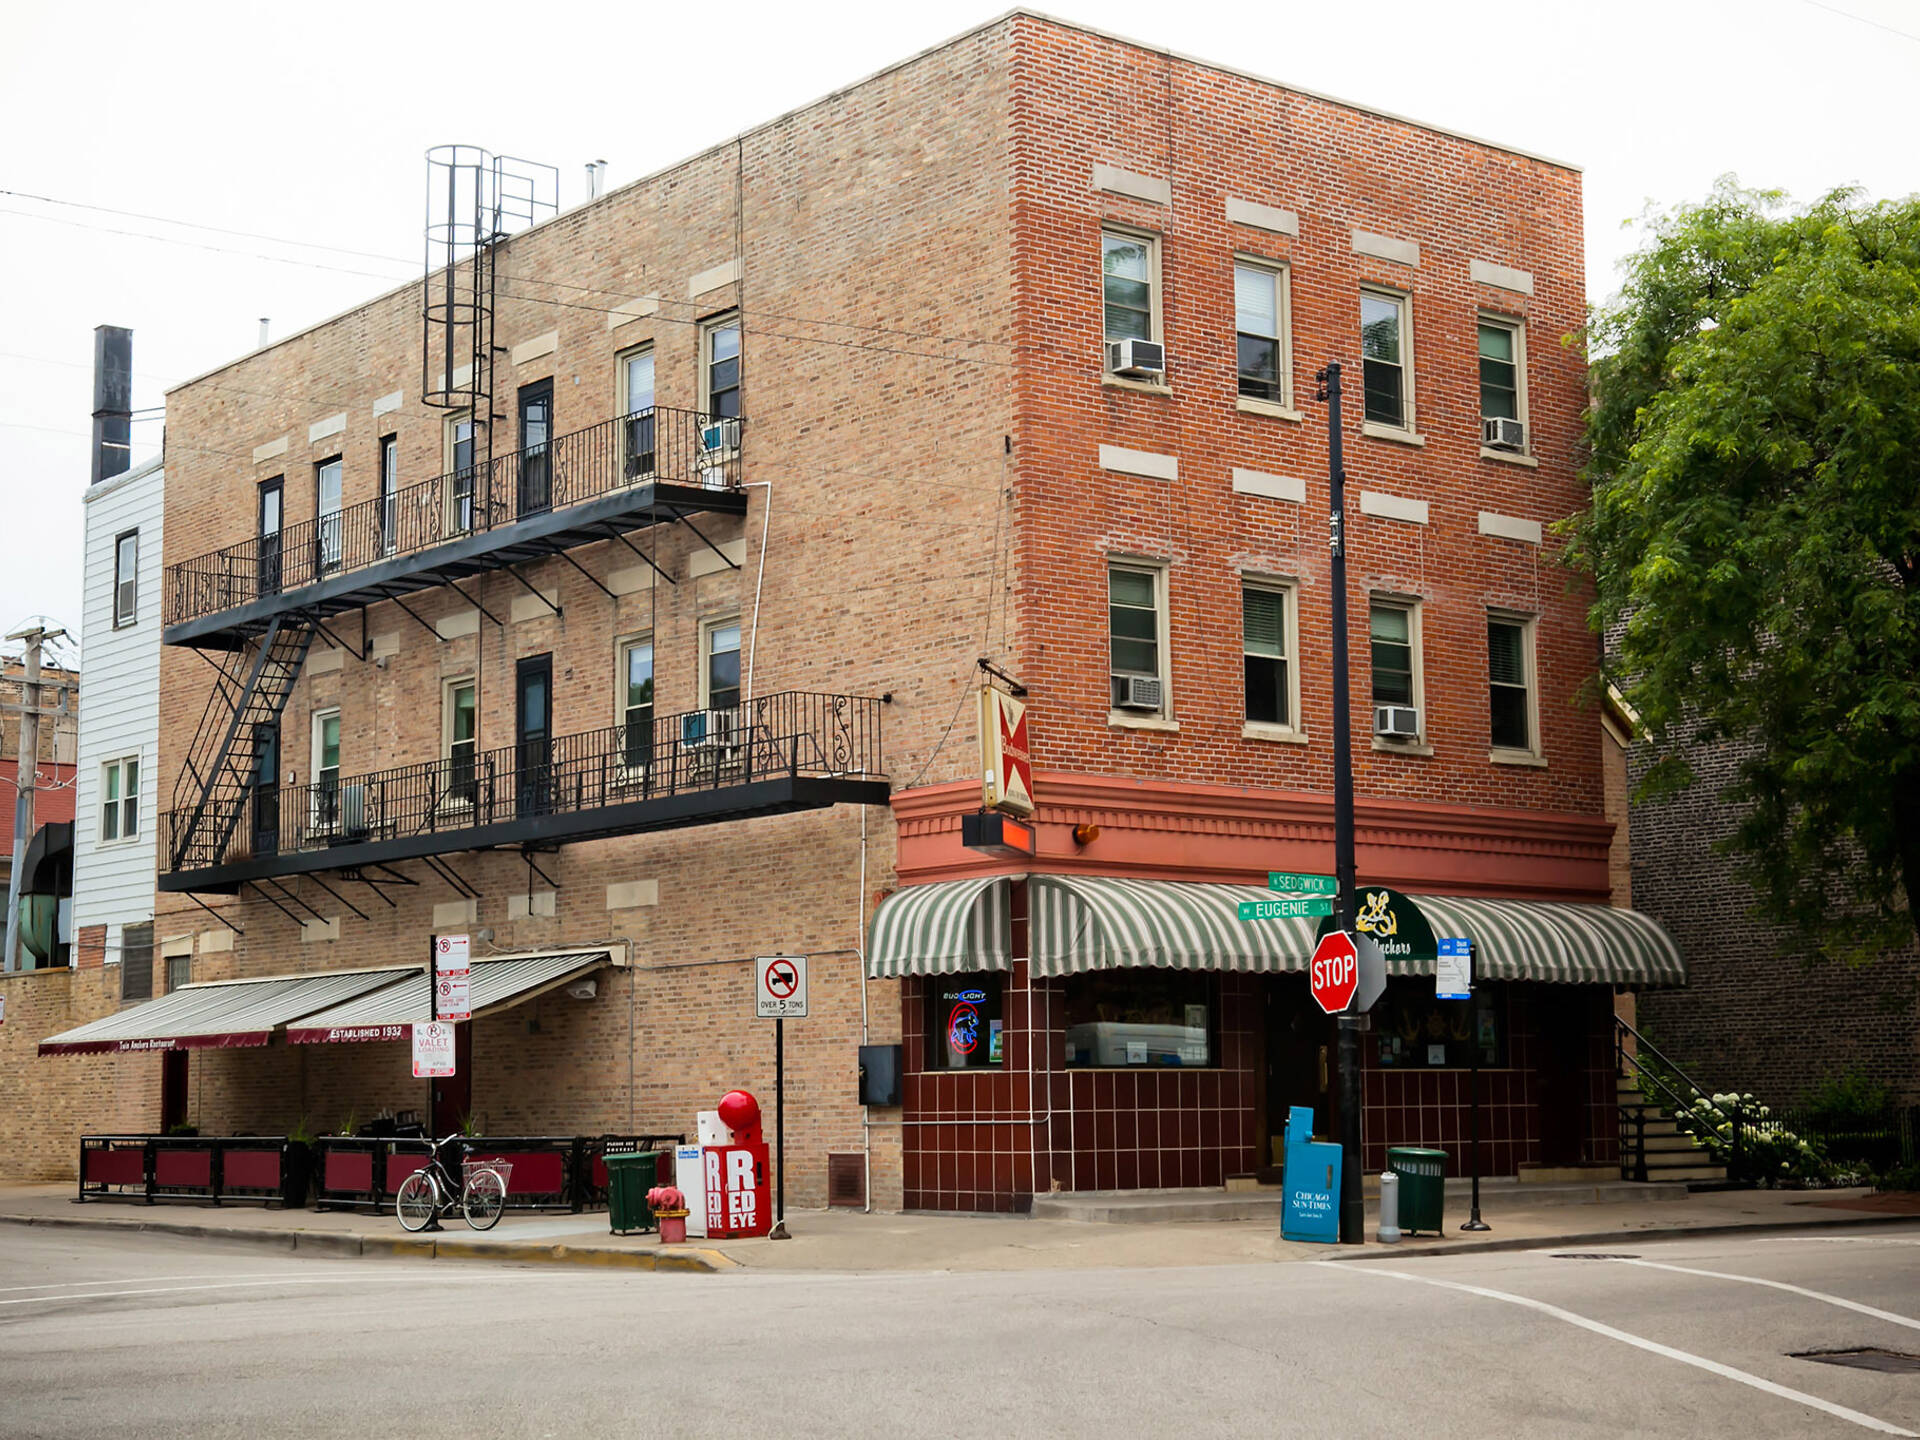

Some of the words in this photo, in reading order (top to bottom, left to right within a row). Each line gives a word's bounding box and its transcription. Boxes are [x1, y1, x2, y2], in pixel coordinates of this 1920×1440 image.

[1279, 875, 1325, 891] SEDGWICK
[1256, 901, 1310, 917] EUGENIE
[1320, 903, 1329, 911] ST
[1314, 955, 1354, 990] STOP
[943, 992, 959, 1000] BUD
[962, 992, 986, 1000] LIGHT
[761, 1001, 777, 1009] OVER
[780, 1000, 786, 1009] 5
[789, 1001, 804, 1009] TONS
[330, 1028, 380, 1038] ESTABLISHED
[382, 1026, 402, 1036] 1932
[418, 1038, 448, 1047] VALET
[726, 1150, 756, 1191] R
[728, 1190, 756, 1214] ED
[1295, 1190, 1330, 1201] CHICAGO
[708, 1213, 722, 1229] EYE
[729, 1212, 757, 1229] EYE
